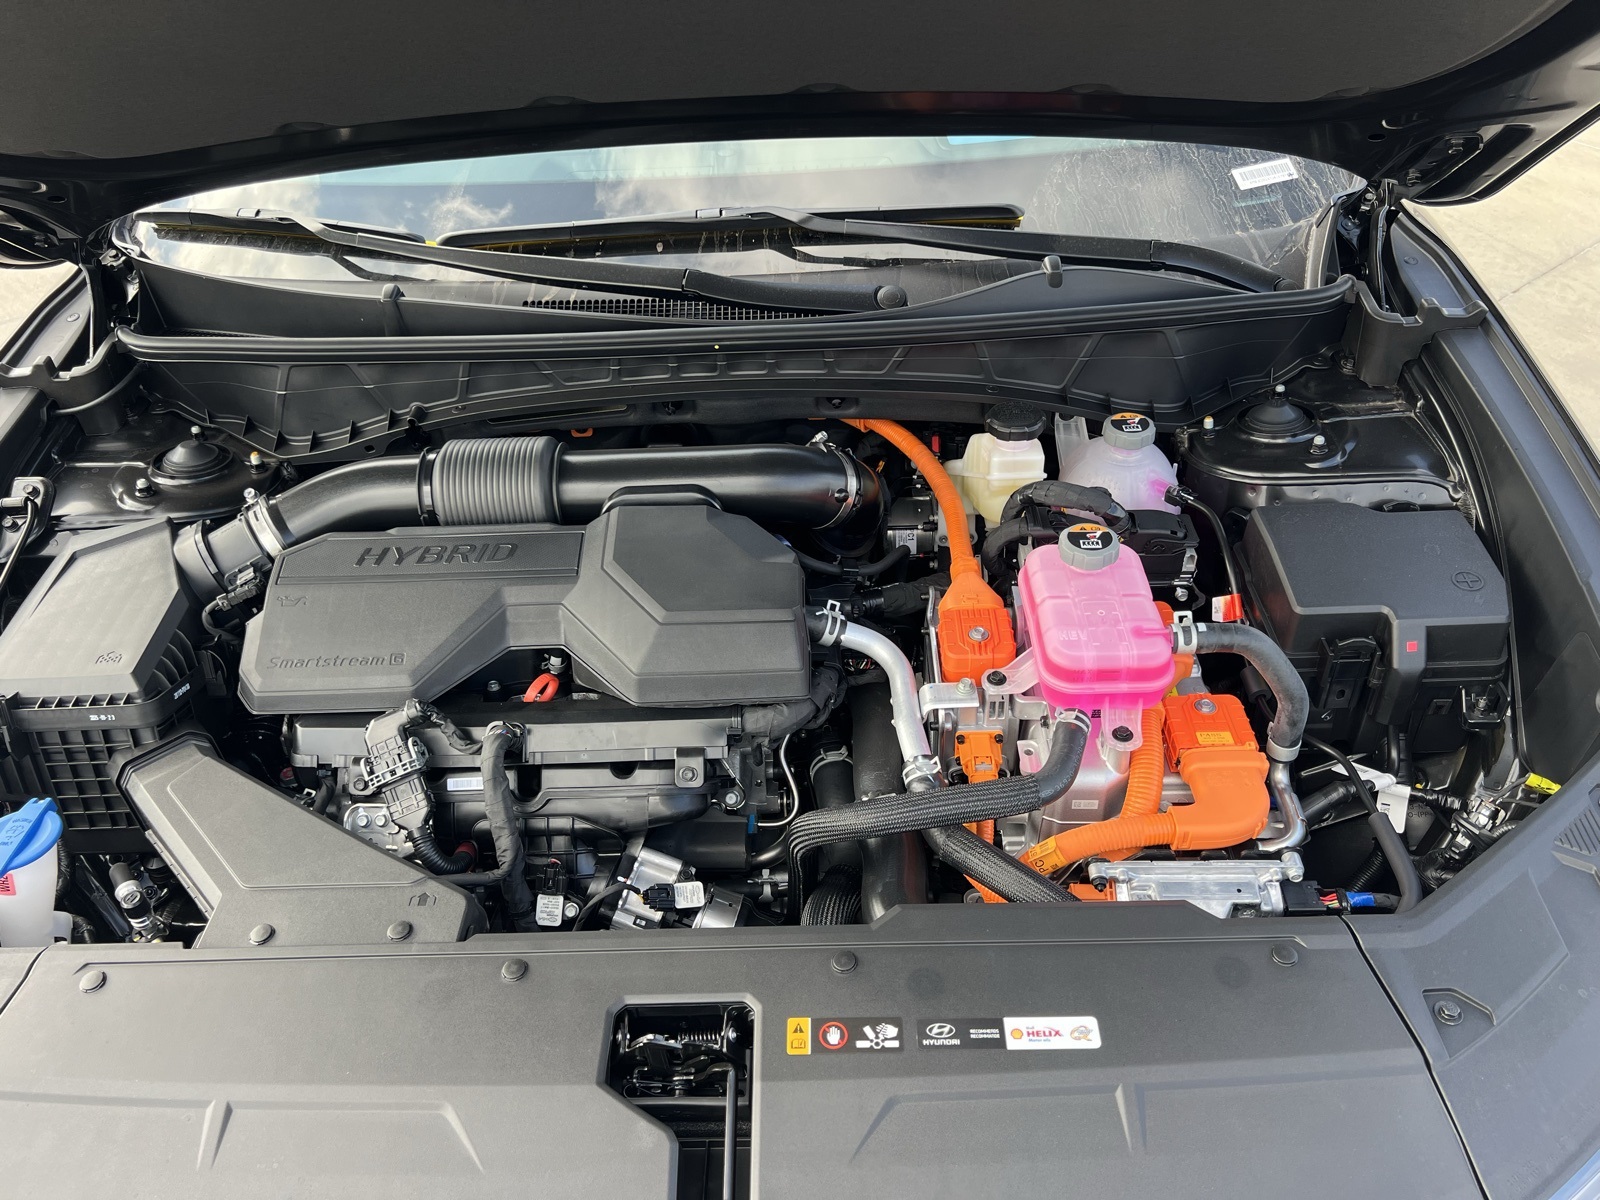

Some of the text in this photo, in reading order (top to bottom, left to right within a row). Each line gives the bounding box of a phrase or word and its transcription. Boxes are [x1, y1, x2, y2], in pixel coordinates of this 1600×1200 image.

[353, 542, 518, 567] HYBRID
[266, 655, 387, 669] Smartstream
[1026, 1030, 1063, 1038] HELIX
[922, 1038, 960, 1046] HYUNDAI
